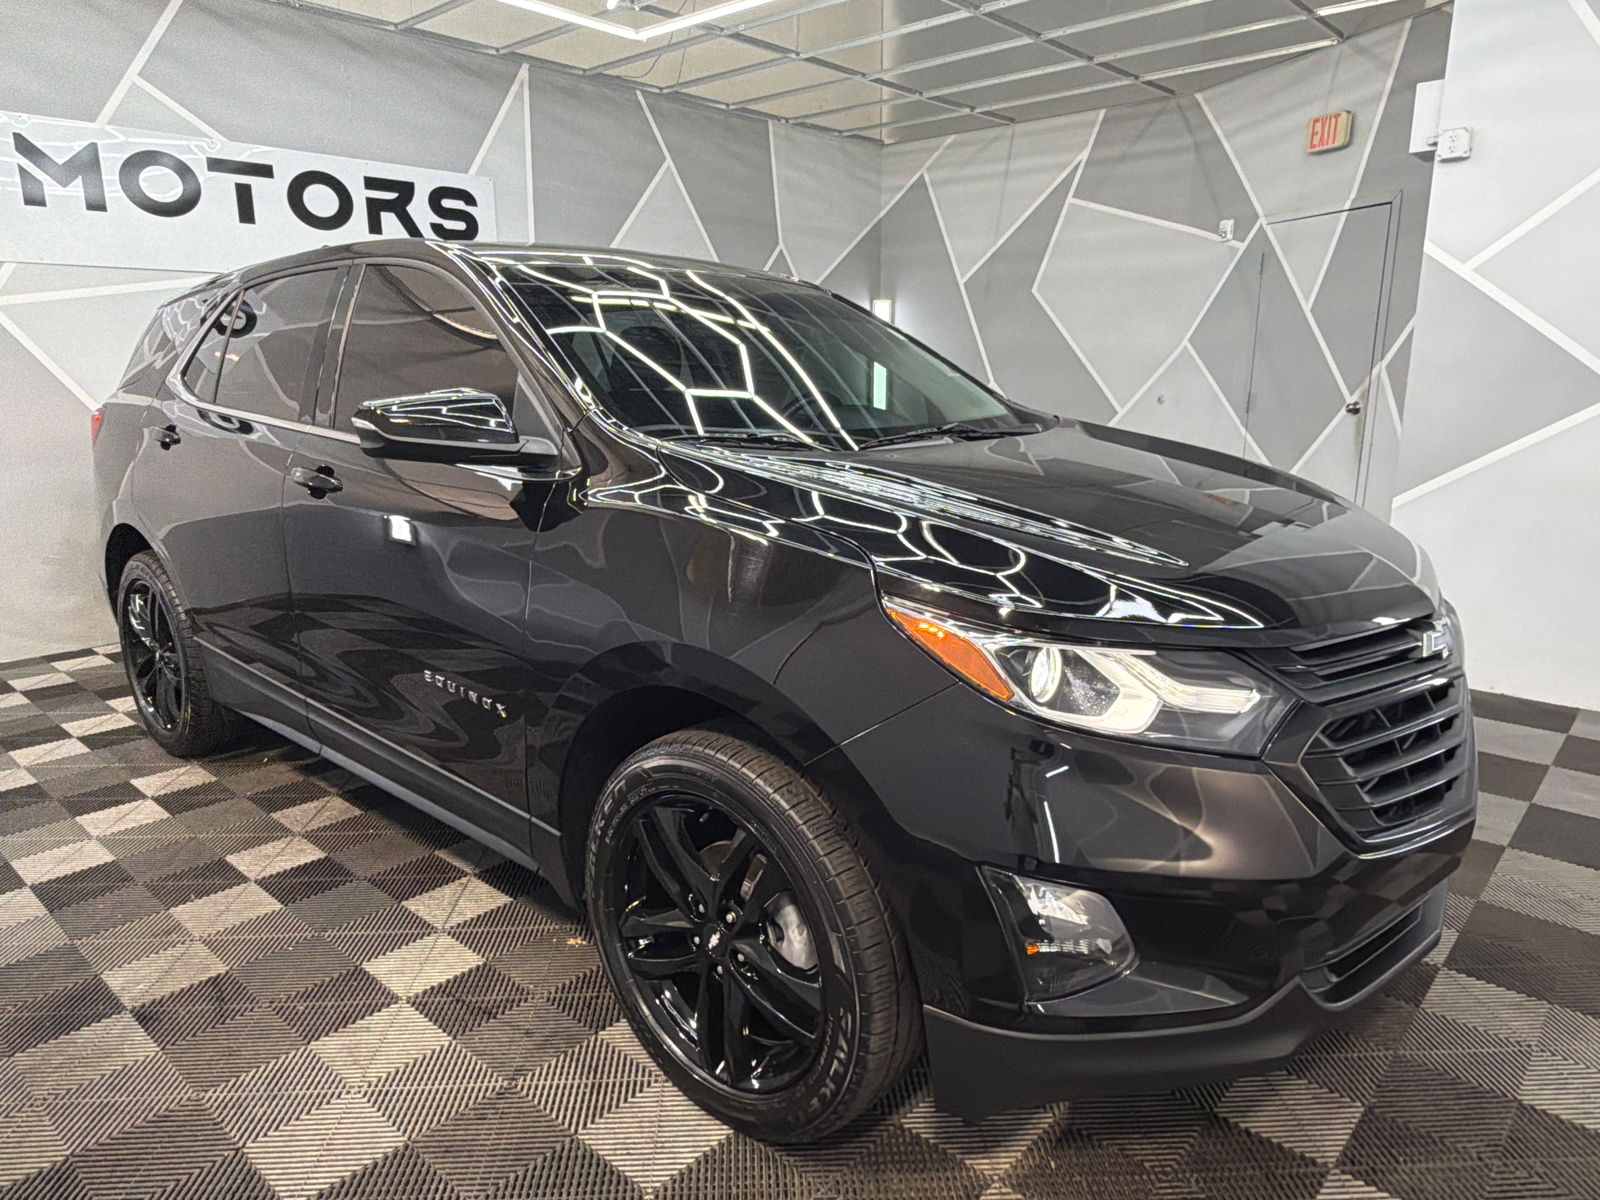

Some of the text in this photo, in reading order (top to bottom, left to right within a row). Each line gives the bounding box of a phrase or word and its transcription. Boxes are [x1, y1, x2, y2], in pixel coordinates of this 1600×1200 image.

[1309, 112, 1342, 150] EXIT
[12, 131, 480, 241] MOTORS
[424, 669, 508, 719] EQUINOX
